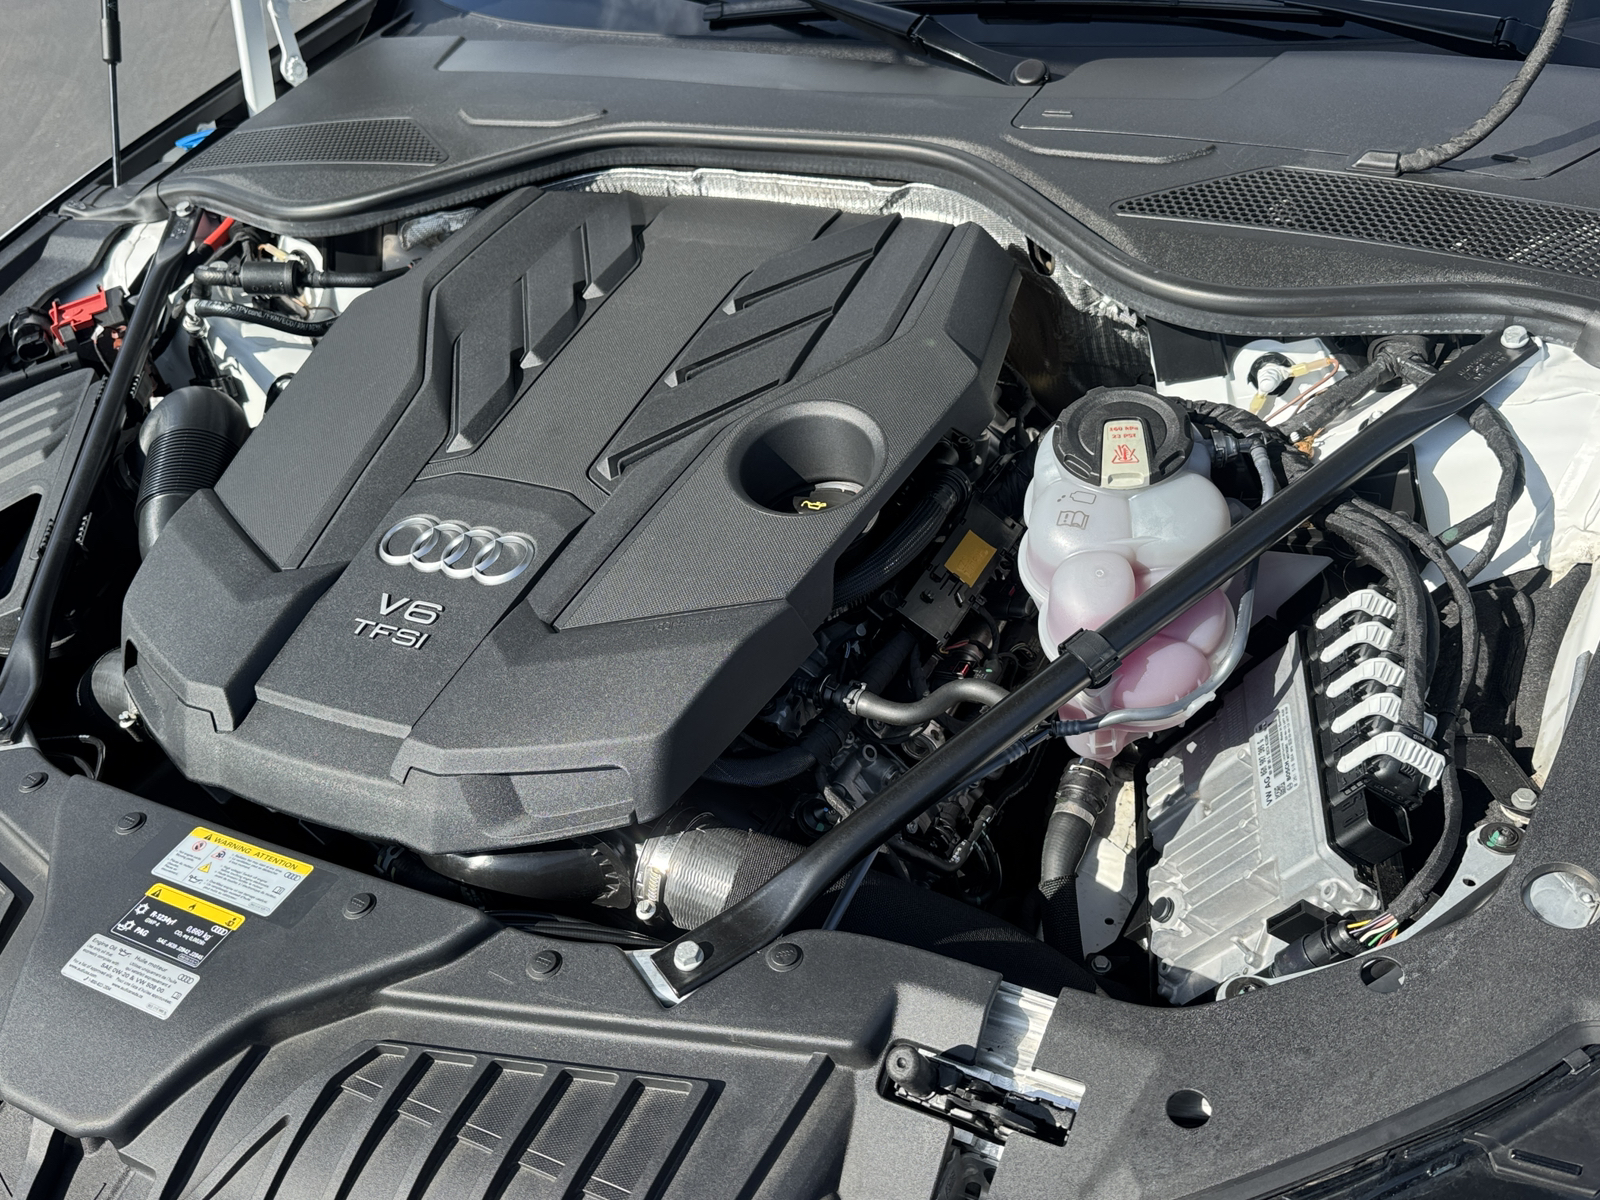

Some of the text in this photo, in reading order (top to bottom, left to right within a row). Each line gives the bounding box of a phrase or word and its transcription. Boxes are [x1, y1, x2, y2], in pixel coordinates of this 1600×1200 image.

[379, 593, 445, 626] V6
[354, 618, 430, 649] TFSI
[1264, 776, 1271, 788] AG
[1265, 790, 1272, 806] VW
[214, 837, 298, 870] WARNING ATTENTION
[150, 911, 178, 925] R-1234yf
[134, 927, 149, 937] PAG
[92, 938, 109, 948] Engine
[156, 937, 168, 945] SAE
[101, 963, 113, 971] SAE
[135, 956, 168, 972] Huile moteur
